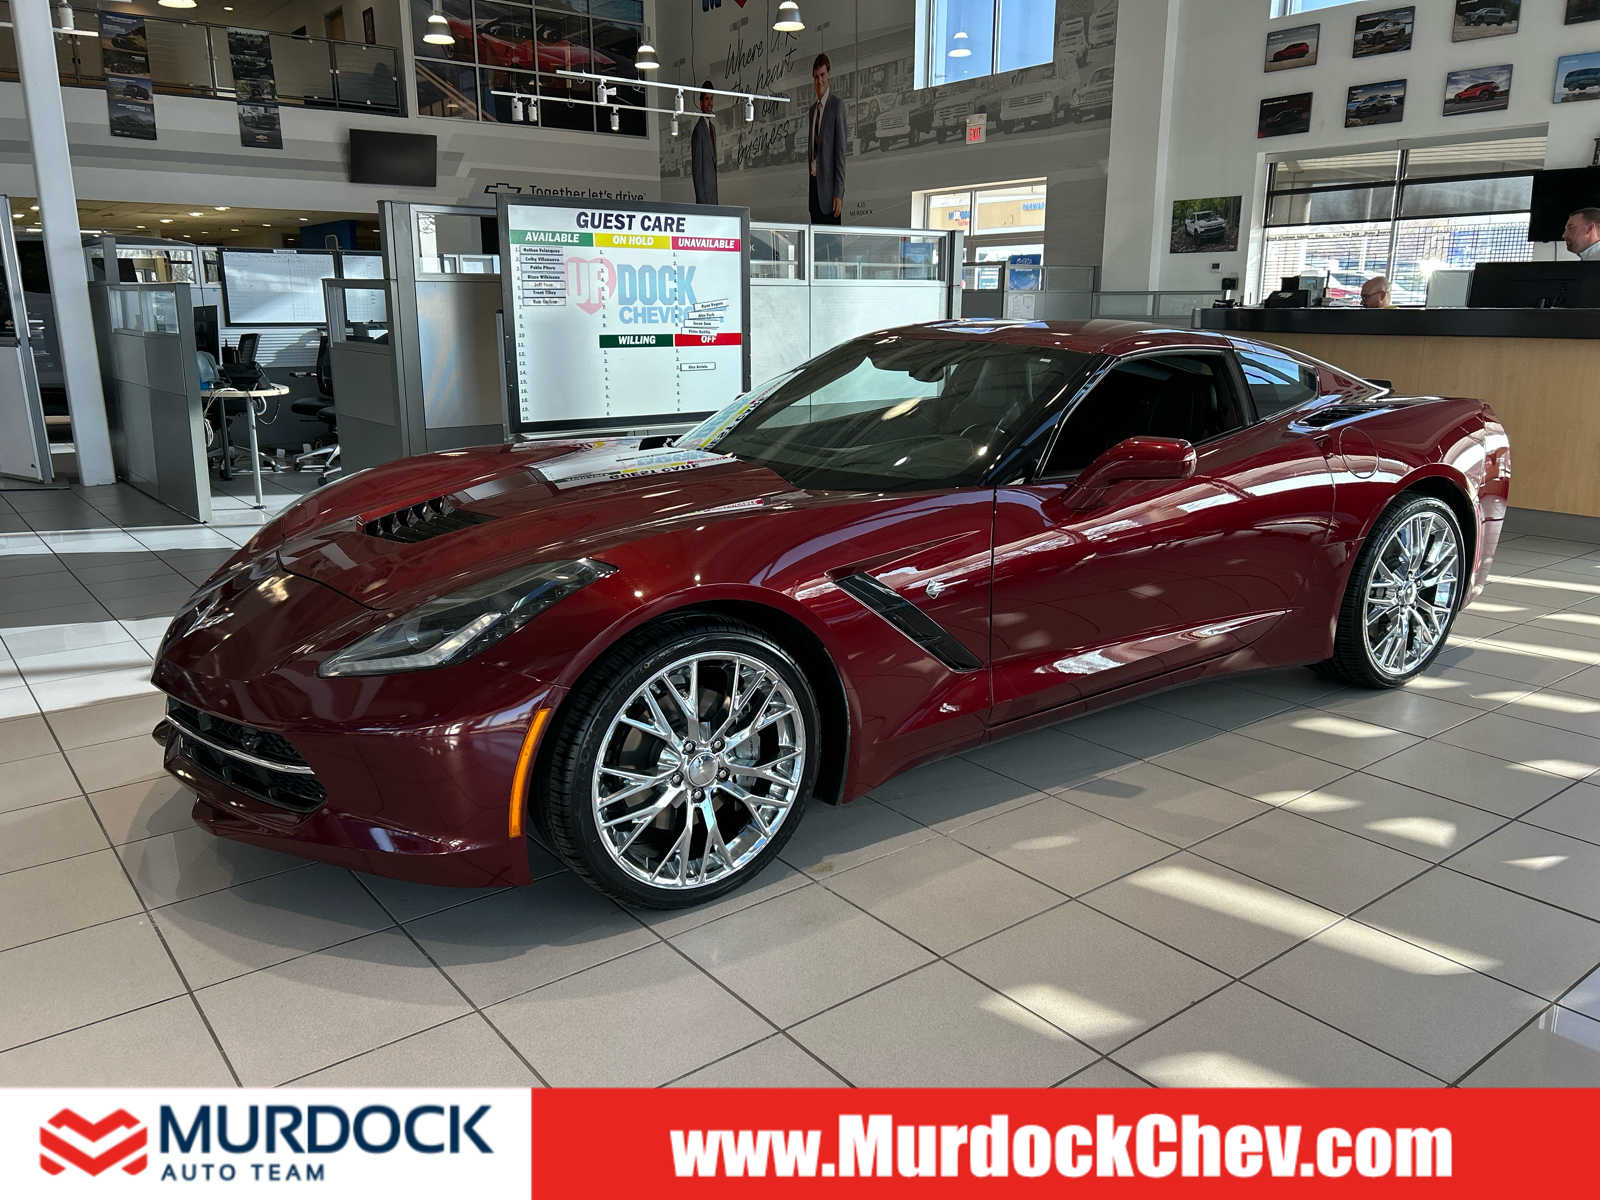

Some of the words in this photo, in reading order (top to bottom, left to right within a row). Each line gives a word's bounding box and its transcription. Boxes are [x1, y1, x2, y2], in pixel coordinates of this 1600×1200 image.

[968, 127, 981, 142] EXIT
[576, 211, 636, 231] GUEST
[640, 215, 686, 233] CARE
[525, 232, 580, 243] AVAILABLE
[612, 235, 627, 245] ON
[628, 236, 654, 247] HOLD
[678, 238, 735, 249] UNAVAILABLE
[617, 264, 697, 305] DOCK
[618, 336, 656, 344] WILLING
